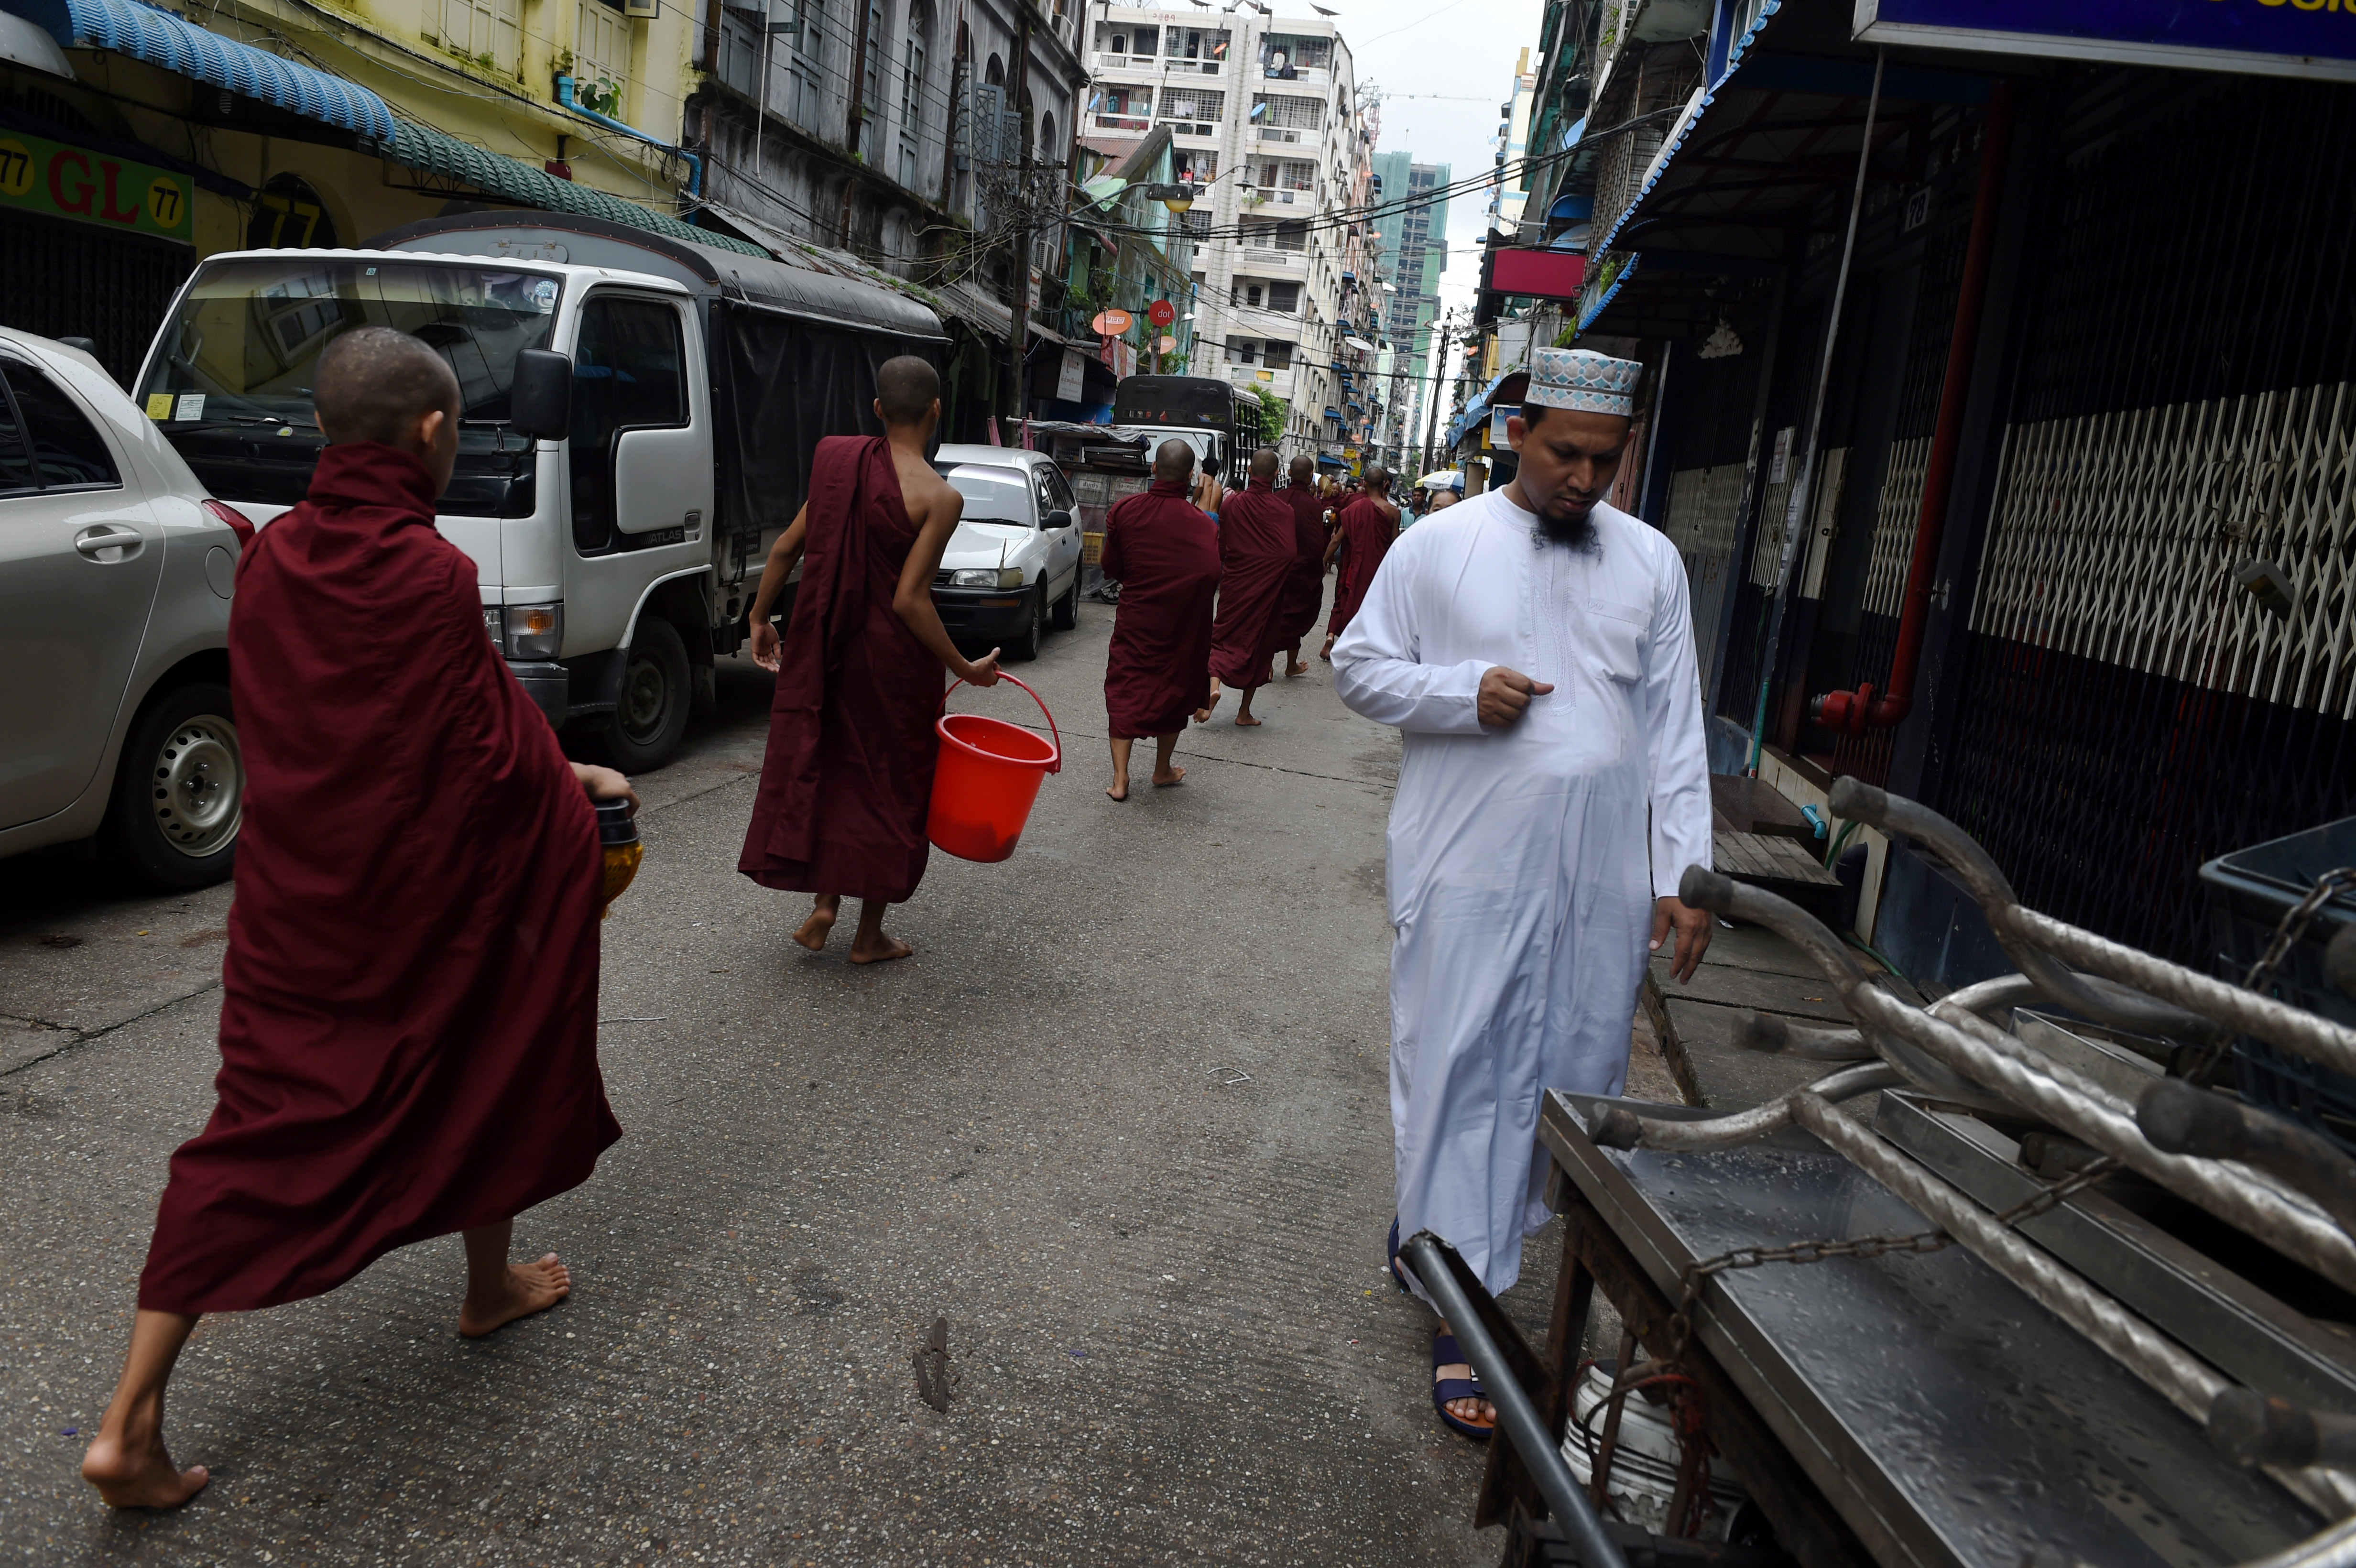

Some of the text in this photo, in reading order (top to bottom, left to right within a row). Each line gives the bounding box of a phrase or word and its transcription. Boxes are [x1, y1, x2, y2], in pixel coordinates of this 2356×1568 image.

[47, 150, 140, 224] GL
[153, 186, 179, 220] 77
[263, 193, 320, 249] 77
[1909, 193, 1926, 228] 78
[1157, 309, 1170, 318] dot
[650, 529, 682, 544] ATLAS
